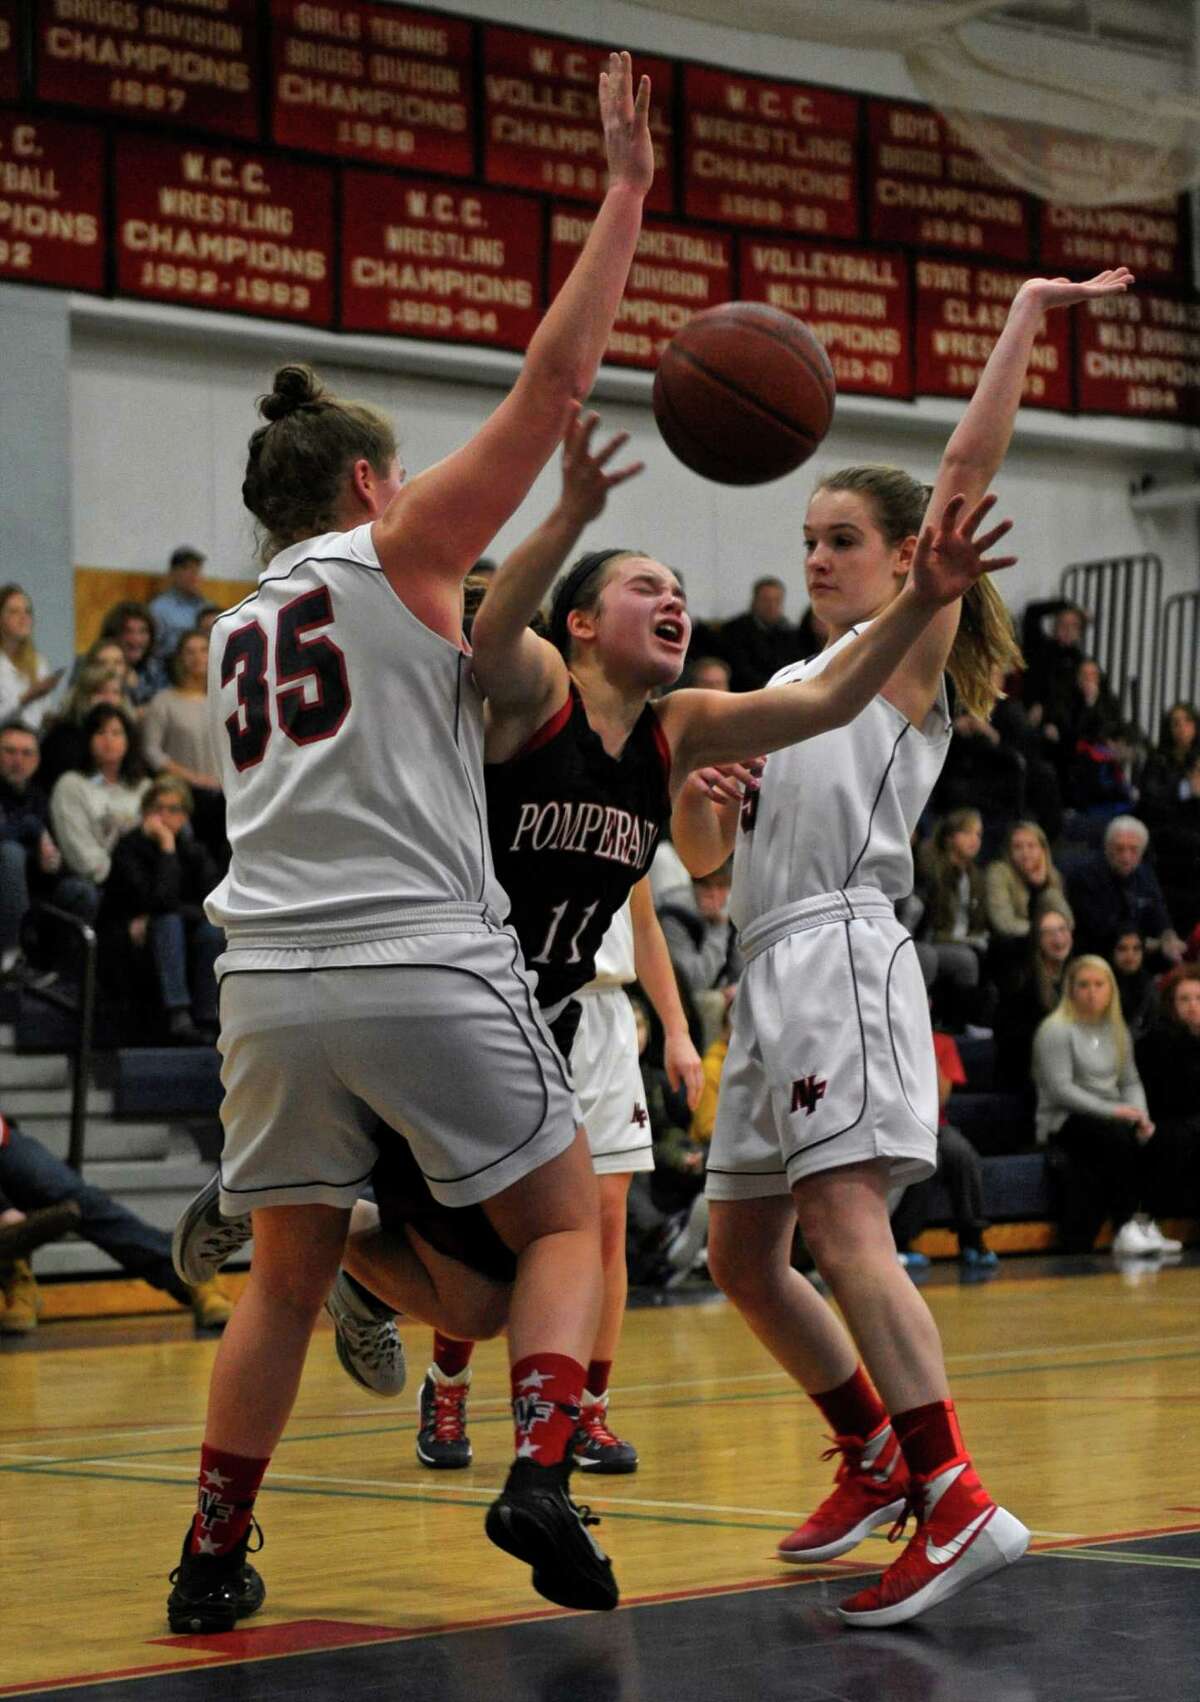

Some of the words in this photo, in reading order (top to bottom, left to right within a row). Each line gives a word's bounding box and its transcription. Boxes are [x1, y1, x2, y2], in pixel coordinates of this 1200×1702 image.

[145, 6, 243, 52] DIVISION
[47, 26, 250, 91] CHAMPIONS
[277, 73, 466, 131] CHAMPIONS
[692, 149, 850, 201] CHAMPIONS
[158, 186, 294, 236] WRESTLING
[123, 219, 328, 281] CHAMPIONS
[384, 224, 506, 269] WRESTLING
[752, 246, 899, 288] VOLLEYBALL
[351, 256, 534, 309] CHAMPIONS
[631, 263, 710, 300] DIVISION
[815, 287, 888, 320] DIVISION
[221, 584, 352, 773] 35
[530, 900, 600, 964] 11
